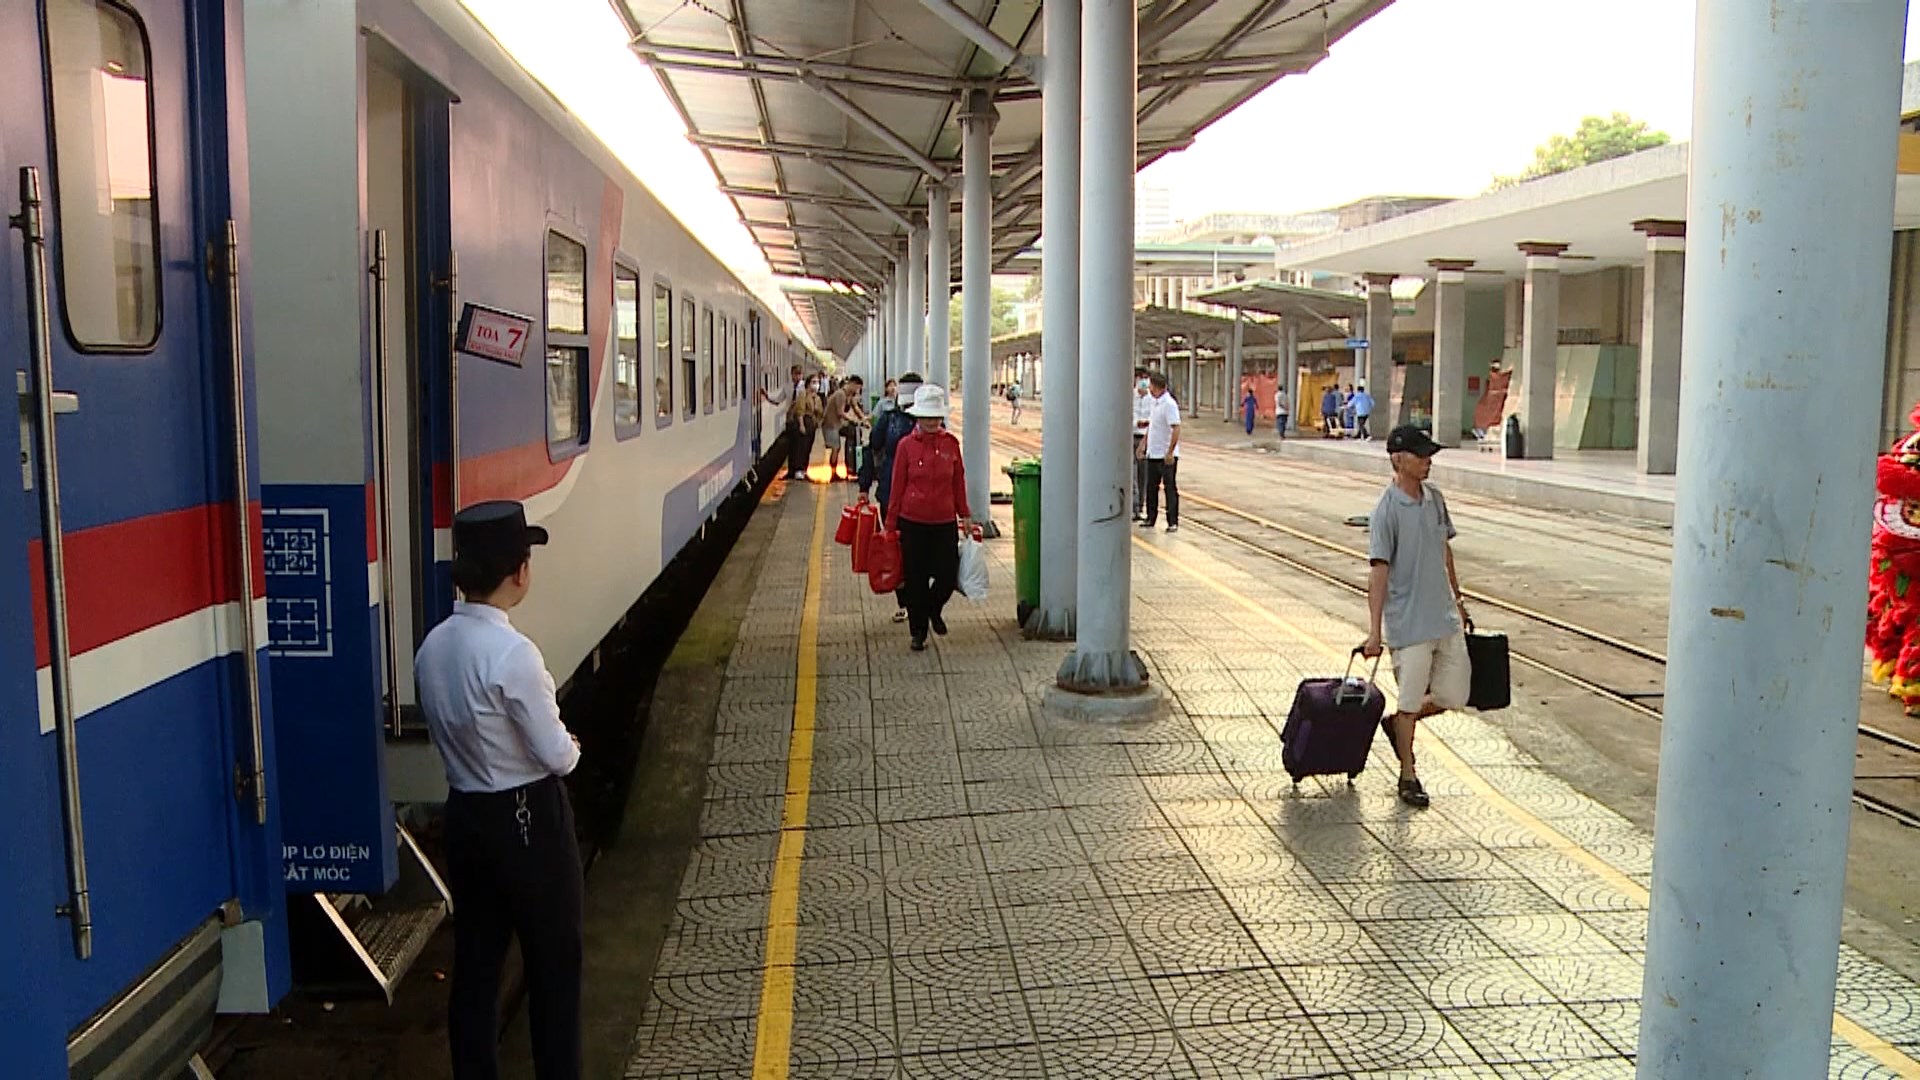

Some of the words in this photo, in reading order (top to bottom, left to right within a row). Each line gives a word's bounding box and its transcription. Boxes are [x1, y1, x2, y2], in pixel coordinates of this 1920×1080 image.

[508, 328, 523, 349] 7
[289, 535, 309, 549] 23
[287, 554, 308, 568] 24
[313, 863, 350, 881] MÓC
